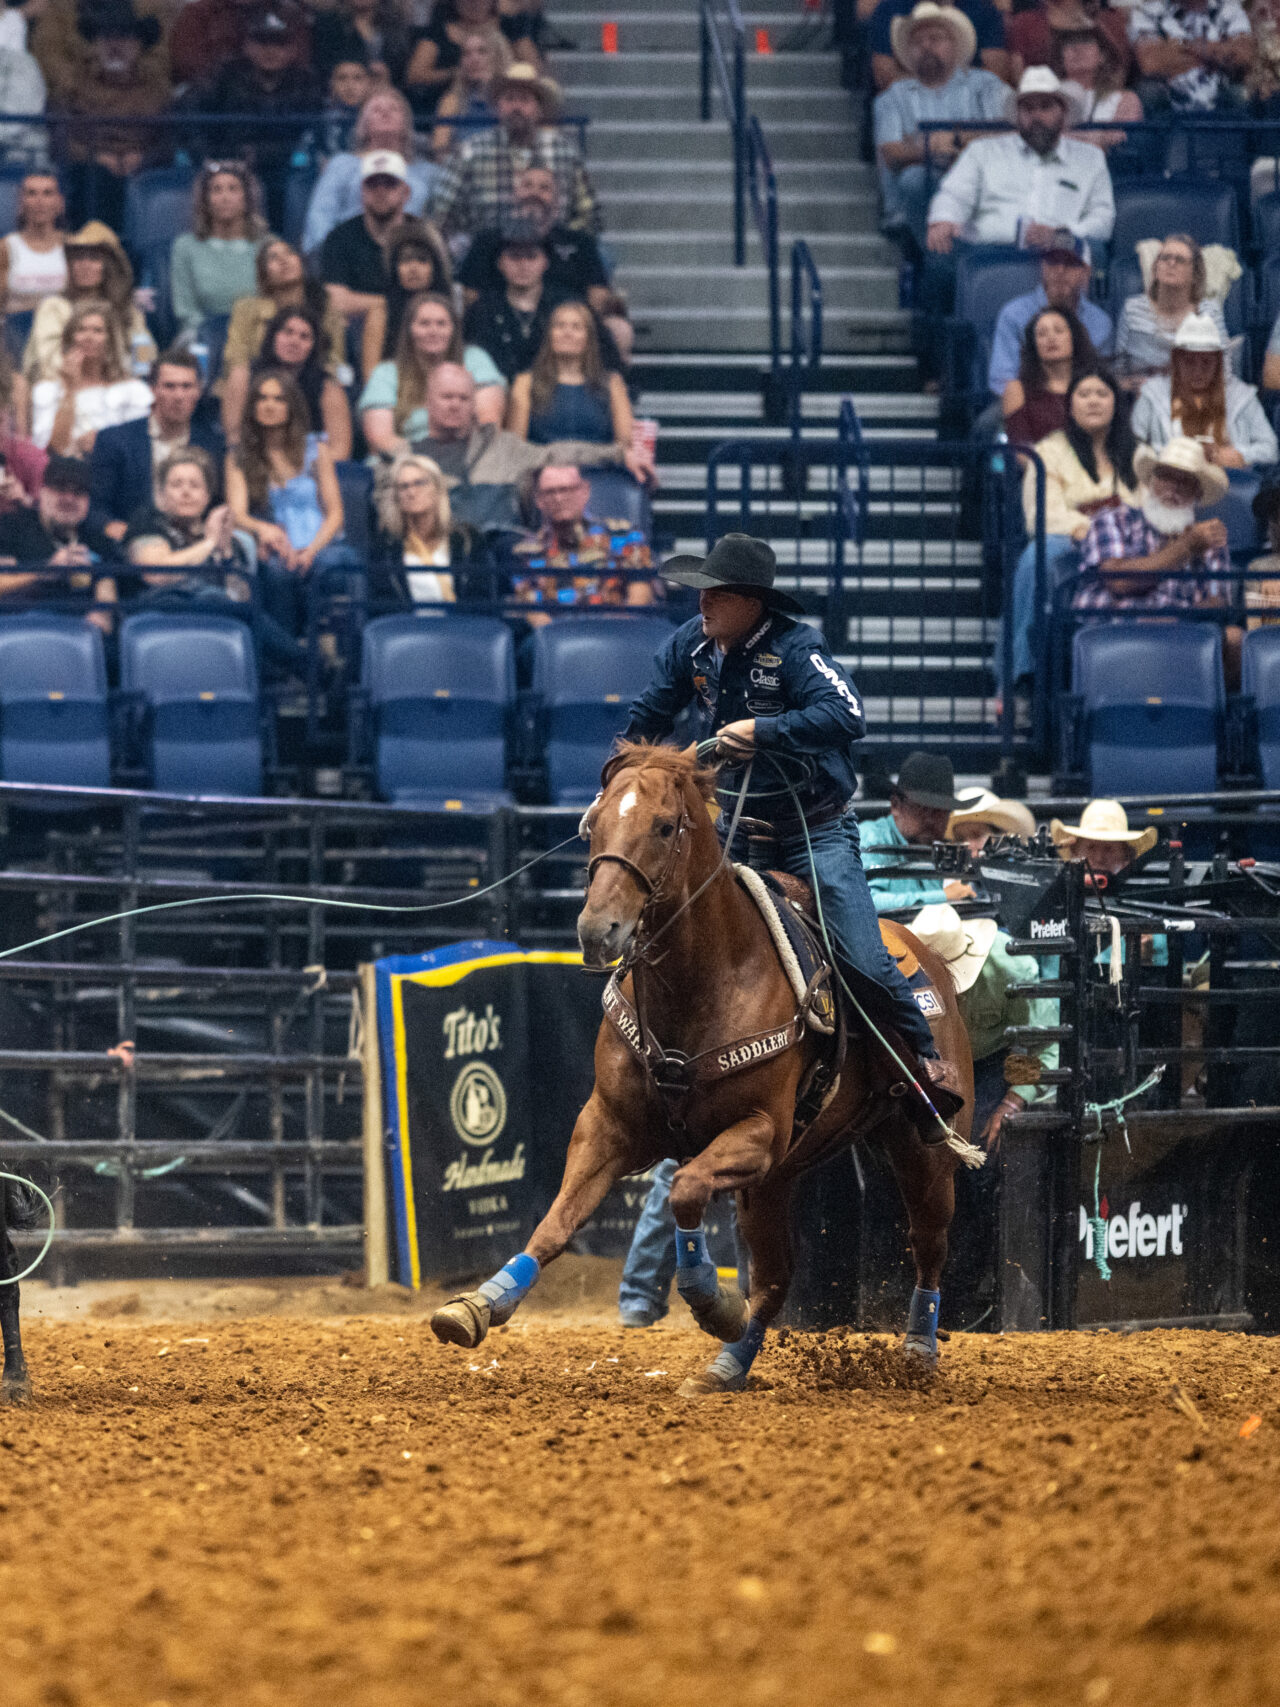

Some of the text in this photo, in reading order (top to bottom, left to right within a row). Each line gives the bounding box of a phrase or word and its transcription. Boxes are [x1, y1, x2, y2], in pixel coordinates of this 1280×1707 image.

[1031, 919, 1066, 938] Priefert
[443, 1004, 501, 1059] Tito's
[718, 1029, 789, 1071] SADDLERY
